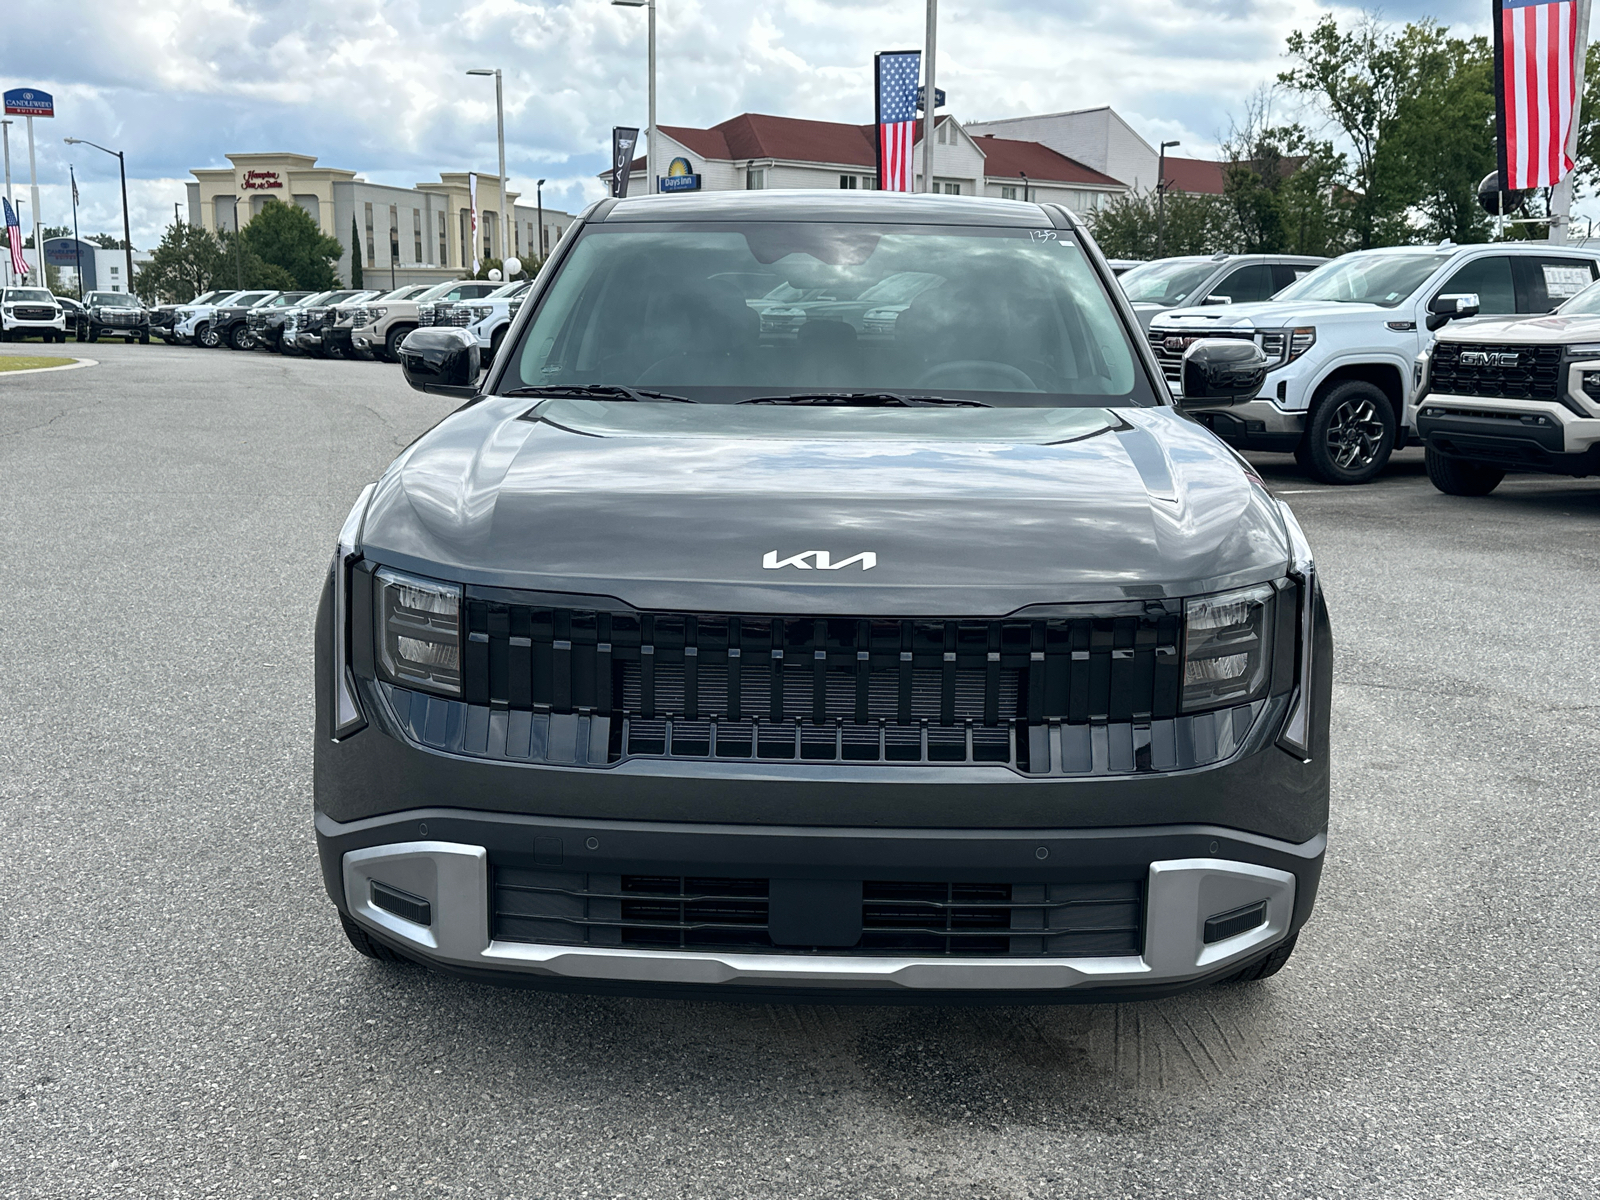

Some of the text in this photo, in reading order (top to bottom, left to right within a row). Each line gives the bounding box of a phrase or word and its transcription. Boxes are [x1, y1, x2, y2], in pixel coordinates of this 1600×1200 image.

[614, 155, 625, 197] LAC
[665, 177, 692, 187] Days Inn
[1460, 351, 1519, 367] GMC
